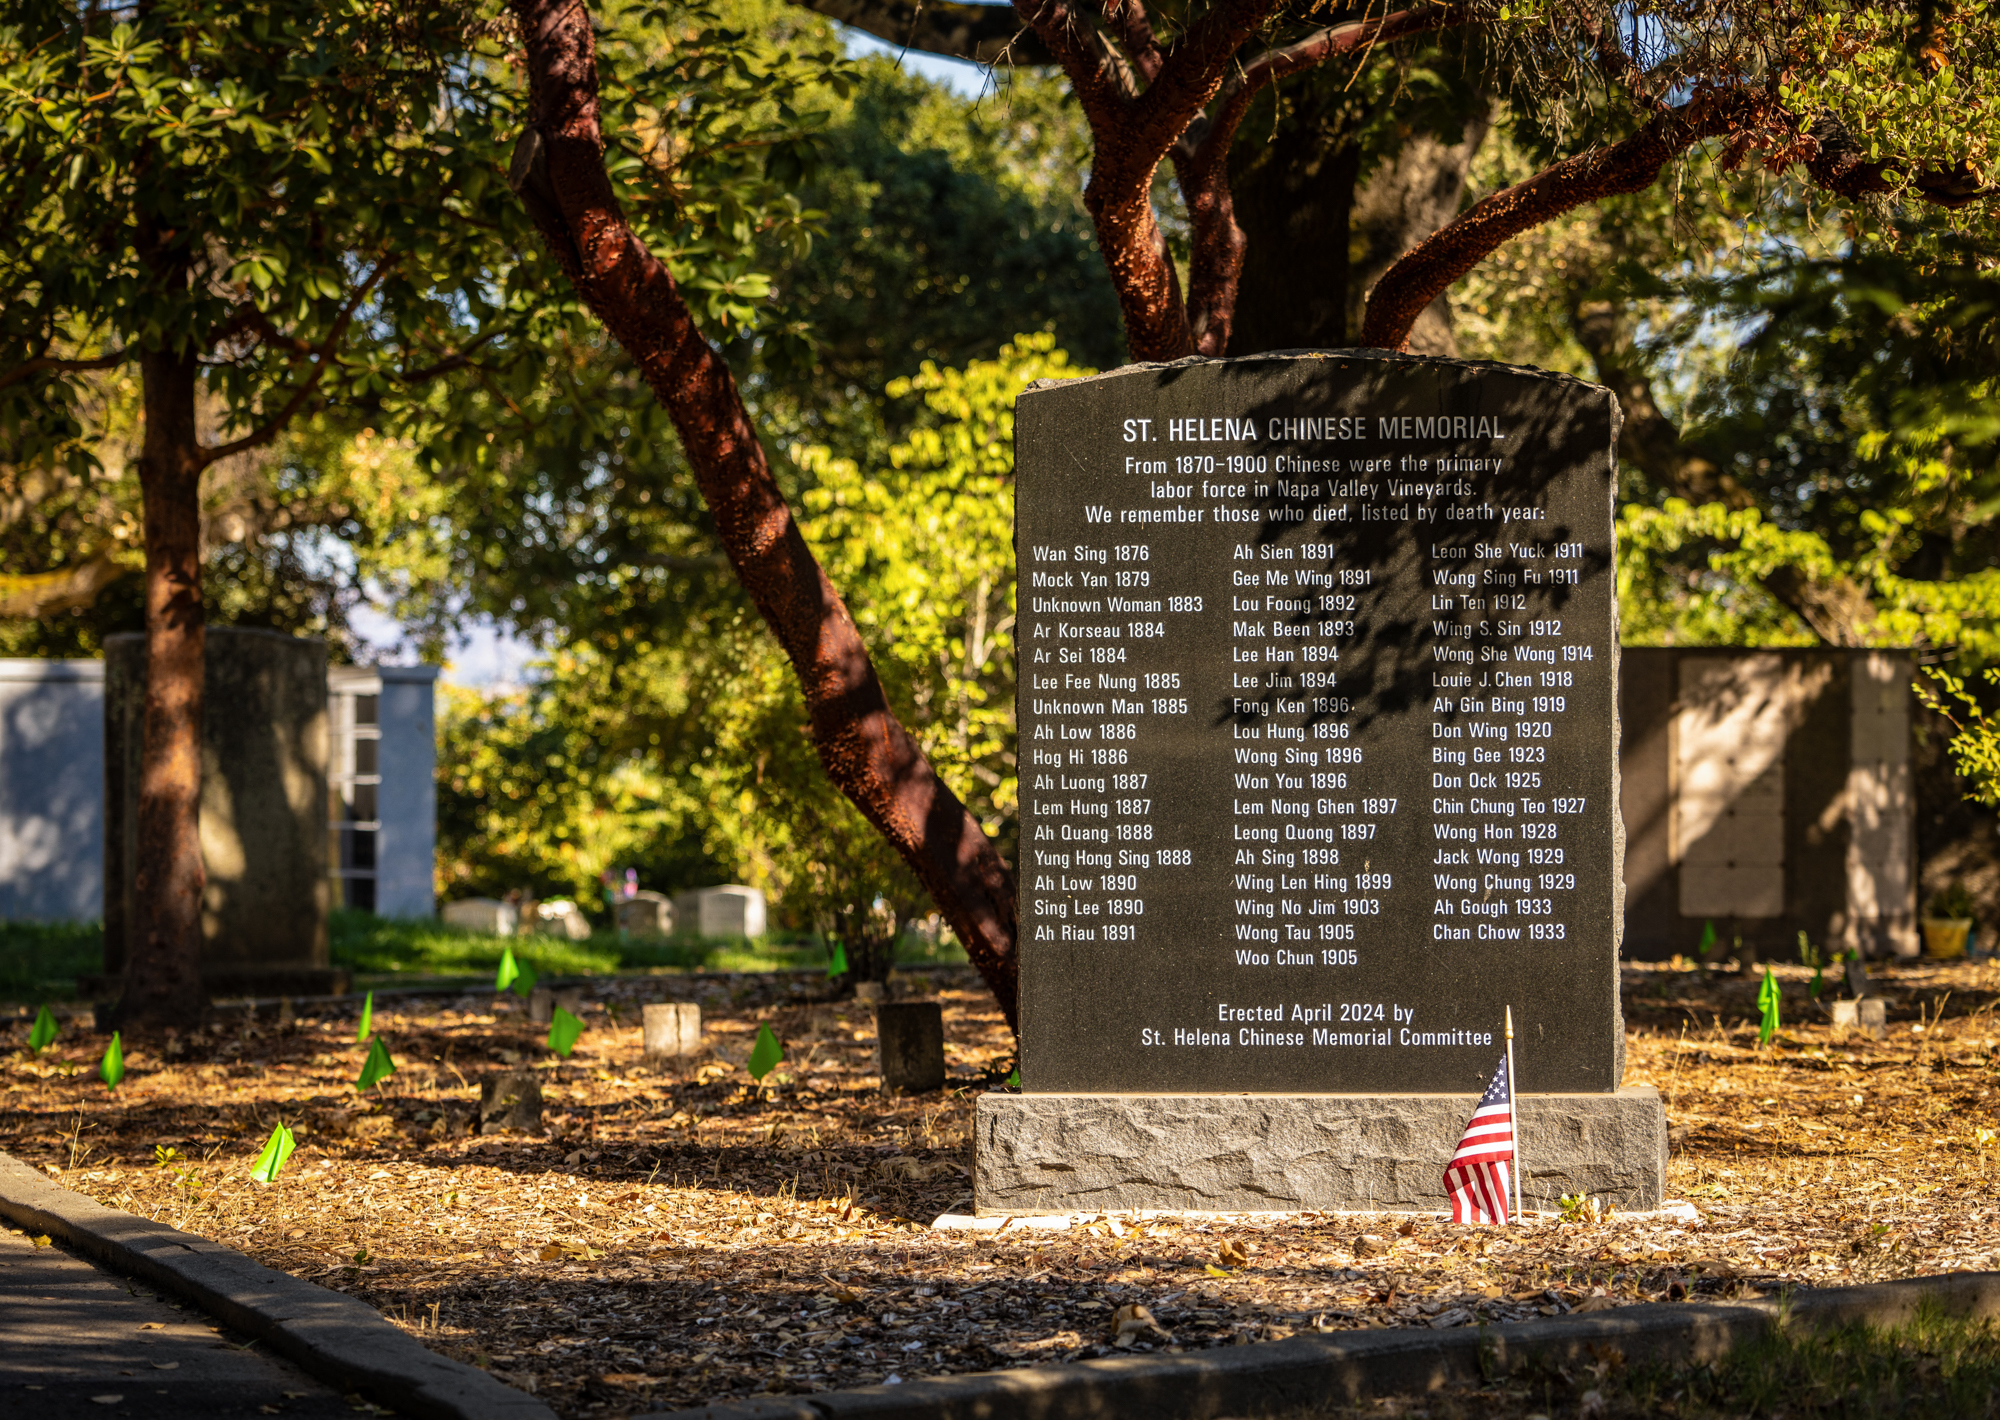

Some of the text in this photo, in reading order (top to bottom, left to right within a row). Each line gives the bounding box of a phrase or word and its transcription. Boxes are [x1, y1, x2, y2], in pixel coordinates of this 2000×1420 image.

[1123, 416, 1505, 442] ST. HELENA CHINESE MEMORIAL
[1126, 457, 1167, 474] From
[1276, 455, 1340, 473] Chinese
[1349, 459, 1391, 472] were
[1400, 454, 1427, 471] the
[1437, 455, 1502, 475] primary
[1151, 478, 1476, 501] labor force in Napa Valley Vineyards.
[1085, 501, 1545, 524] We remember those who died, listed by death year:
[1033, 544, 1149, 564] Wan Sing 1876
[1233, 543, 1334, 560] Ah Sien 1891
[1033, 571, 1150, 589] Mock Yan 1879
[1233, 568, 1372, 589] Gee Me Wing 1891
[1033, 596, 1203, 613] Unknown Woman 1883
[1432, 594, 1526, 610] Lin Ten 1912
[1033, 622, 1165, 638] Ar Korseau 1884
[1233, 621, 1354, 637] Mak Been 1893
[1234, 646, 1339, 662] Lee Han 1894
[1433, 645, 1594, 665] Wong She Wong 1914
[1034, 671, 1180, 692] Lee Fee Nung 1885
[1033, 698, 1189, 715] Unknown Man 1885
[1433, 696, 1566, 716] Ah Gin Bing 1919
[1034, 723, 1136, 739] Ah Low 1886
[1234, 723, 1350, 742] Lou Hung 1896
[1433, 722, 1552, 741] Don Wing 1920
[1234, 747, 1363, 767] Wong Sing 1896
[1433, 747, 1546, 766] Bing Gee 1923
[1033, 774, 1148, 793] Ah Luong 1887
[1234, 773, 1347, 790] Won You 1896
[1433, 772, 1542, 788] Don Ock 1925
[1034, 799, 1151, 818] Lem Hung 1887
[1234, 797, 1398, 818] Lem Nong Ghen 1897
[1433, 798, 1586, 817] Chin Chung Teo 1927
[1034, 824, 1153, 843] Ah Quang 1888
[1234, 824, 1376, 843] Leong Quong 1897
[1433, 823, 1557, 843] Wong Hon 1928
[1034, 849, 1193, 869] Yung Hong Sing 1888
[1433, 848, 1564, 868] Jack Wong 1929
[1035, 899, 1143, 918] Sing Lee 1890
[1235, 899, 1380, 918] Wing No Jim 1903
[1434, 899, 1552, 918] Ah Gough 1933
[1035, 924, 1135, 941] Ah Riau 1891
[1235, 924, 1355, 943] Wong Tau 1905
[1433, 923, 1566, 941] Chan Chow 1933
[1235, 949, 1358, 966] Woo Chun 1905
[1219, 1003, 1414, 1025] Erected April 2024 by
[1142, 1028, 1492, 1046] St. Helena Chinese Memorial Committee
